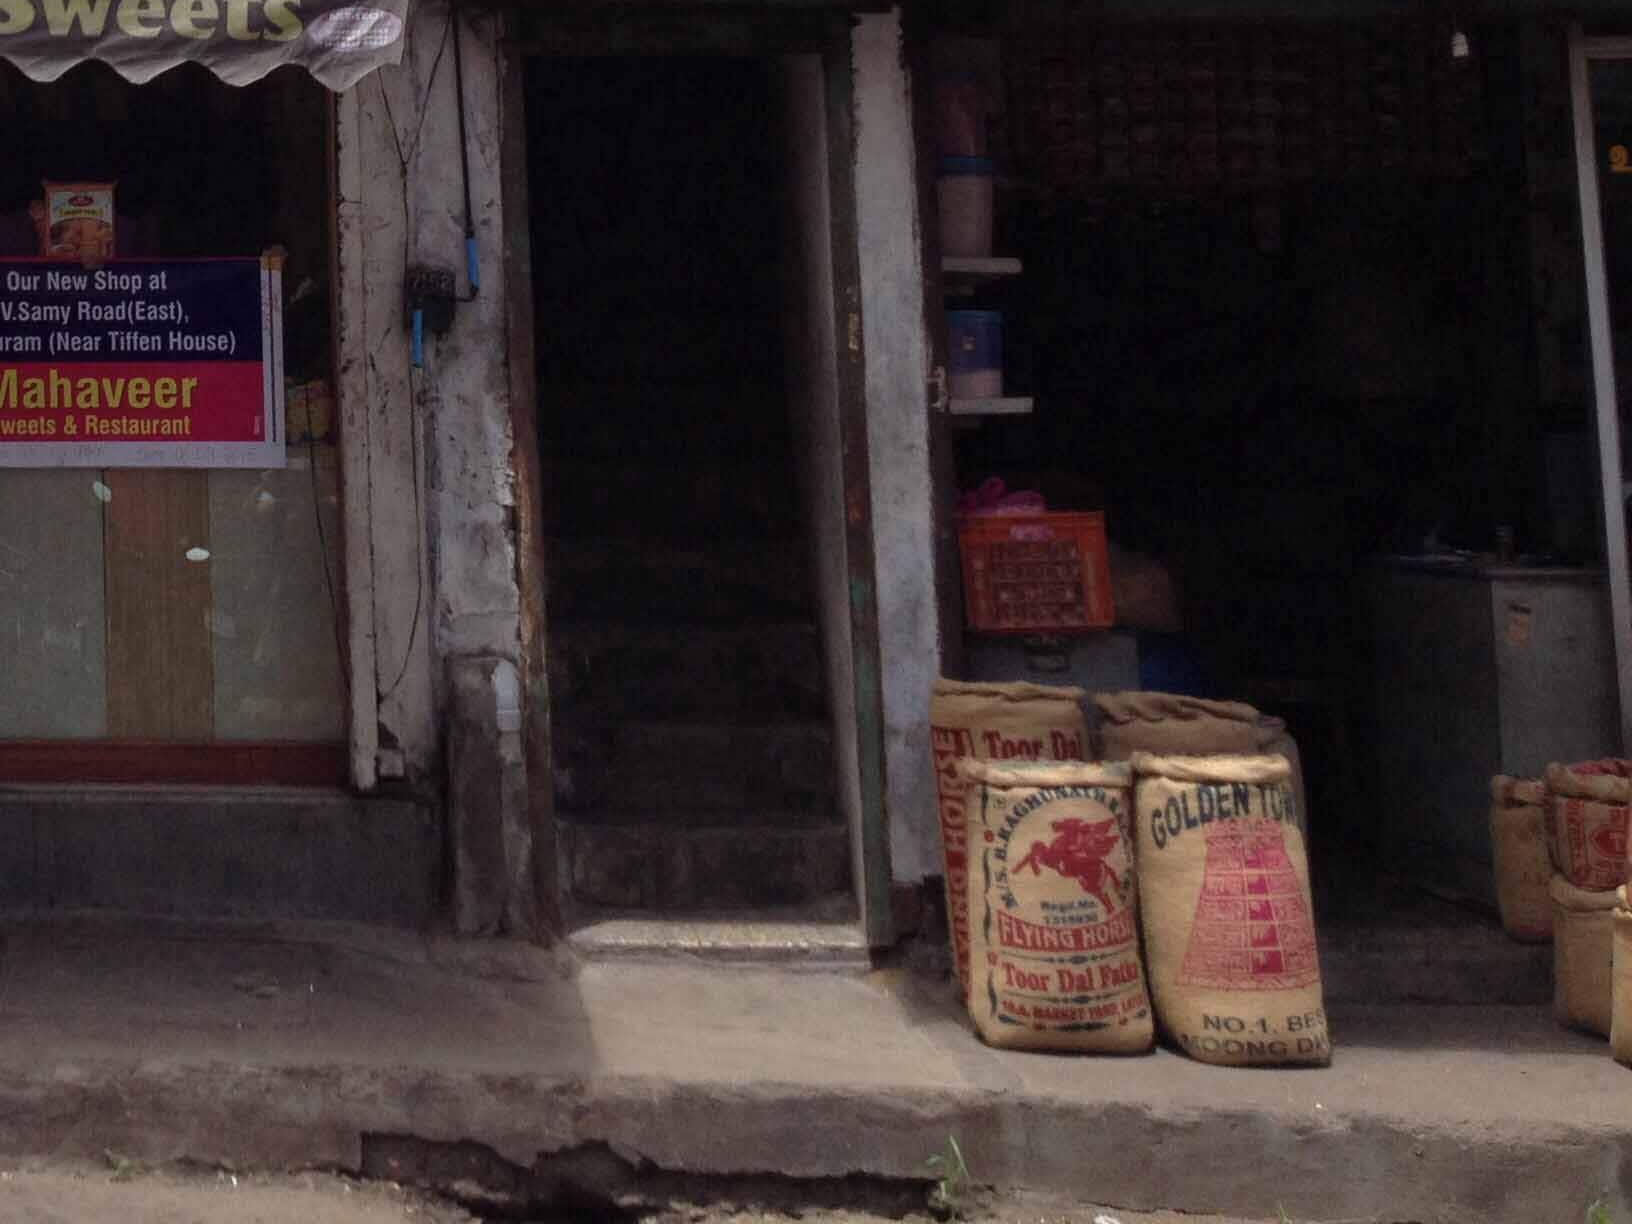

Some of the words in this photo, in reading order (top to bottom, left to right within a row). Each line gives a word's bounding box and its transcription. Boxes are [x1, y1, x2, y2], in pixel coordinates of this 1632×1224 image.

[6, 271, 39, 292] Our
[47, 270, 86, 291] New
[94, 270, 142, 296] Shop
[149, 271, 167, 290] at
[49, 330, 100, 355] (Near
[108, 330, 162, 352] Tiffen
[169, 329, 236, 354] House)
[64, 416, 77, 435] &
[86, 414, 191, 436] Restaurant
[1000, 912, 1074, 949] FLYING
[1003, 962, 1049, 990] Toor
